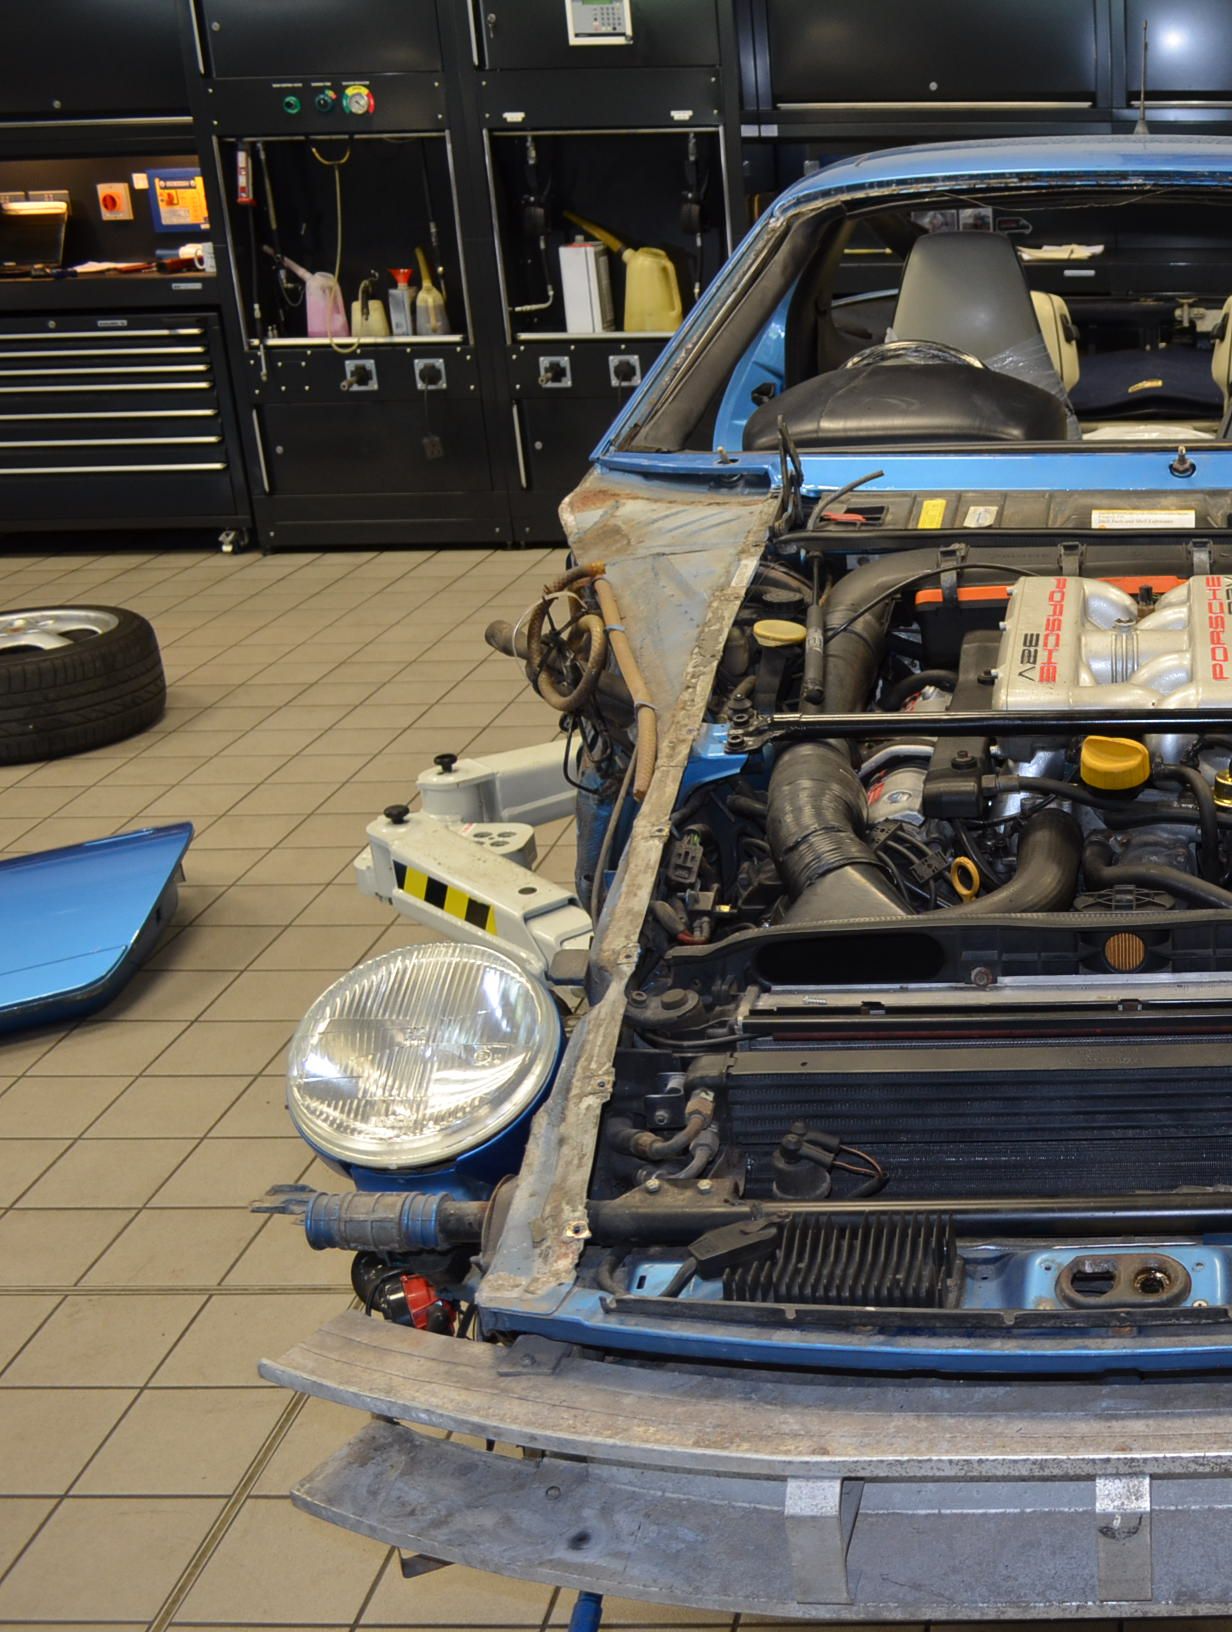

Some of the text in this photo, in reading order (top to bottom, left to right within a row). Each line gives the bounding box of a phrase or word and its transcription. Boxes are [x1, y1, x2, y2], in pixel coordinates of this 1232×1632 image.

[1018, 633, 1040, 682] 32V
[1040, 577, 1067, 683] PORSCHE
[1206, 575, 1230, 681] PORSCHE
